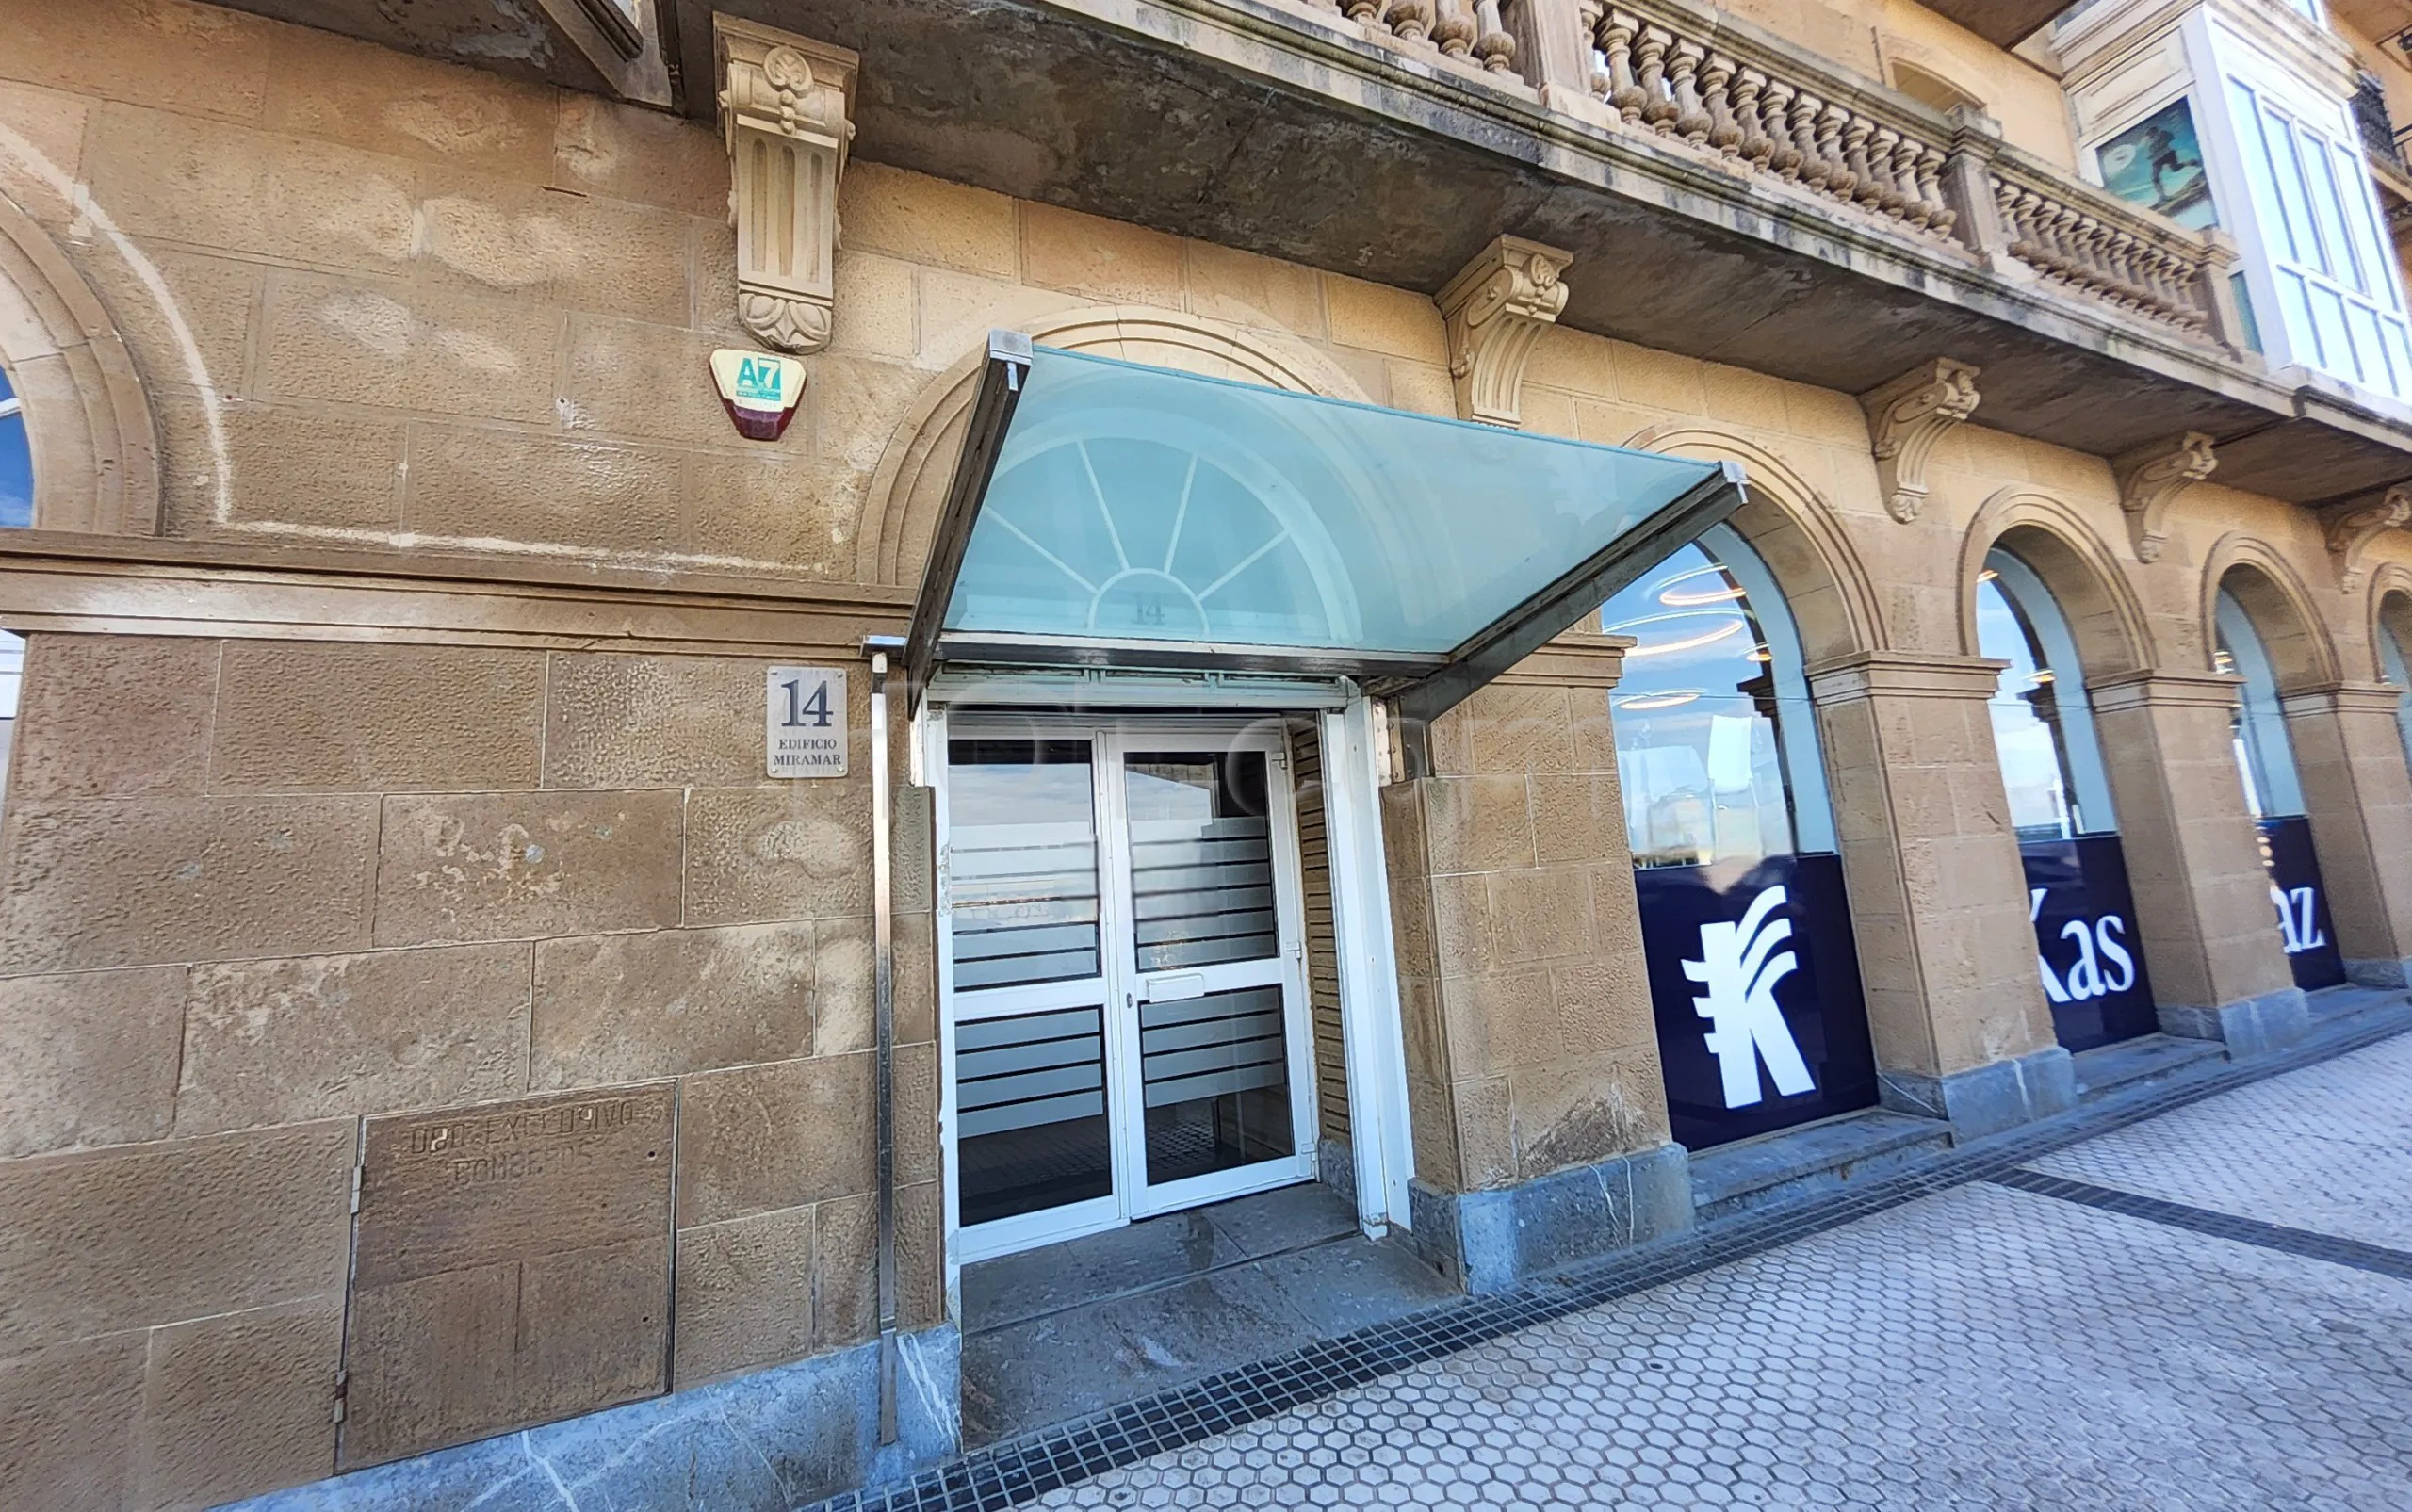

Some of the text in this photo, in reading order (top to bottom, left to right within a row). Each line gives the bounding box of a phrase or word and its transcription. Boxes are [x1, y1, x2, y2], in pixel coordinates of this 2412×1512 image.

[737, 357, 781, 390] A7
[1131, 592, 1166, 626] 14
[781, 679, 834, 727] 14
[773, 754, 842, 766] MIRAMAR
[778, 739, 838, 751] EDIFICIO
